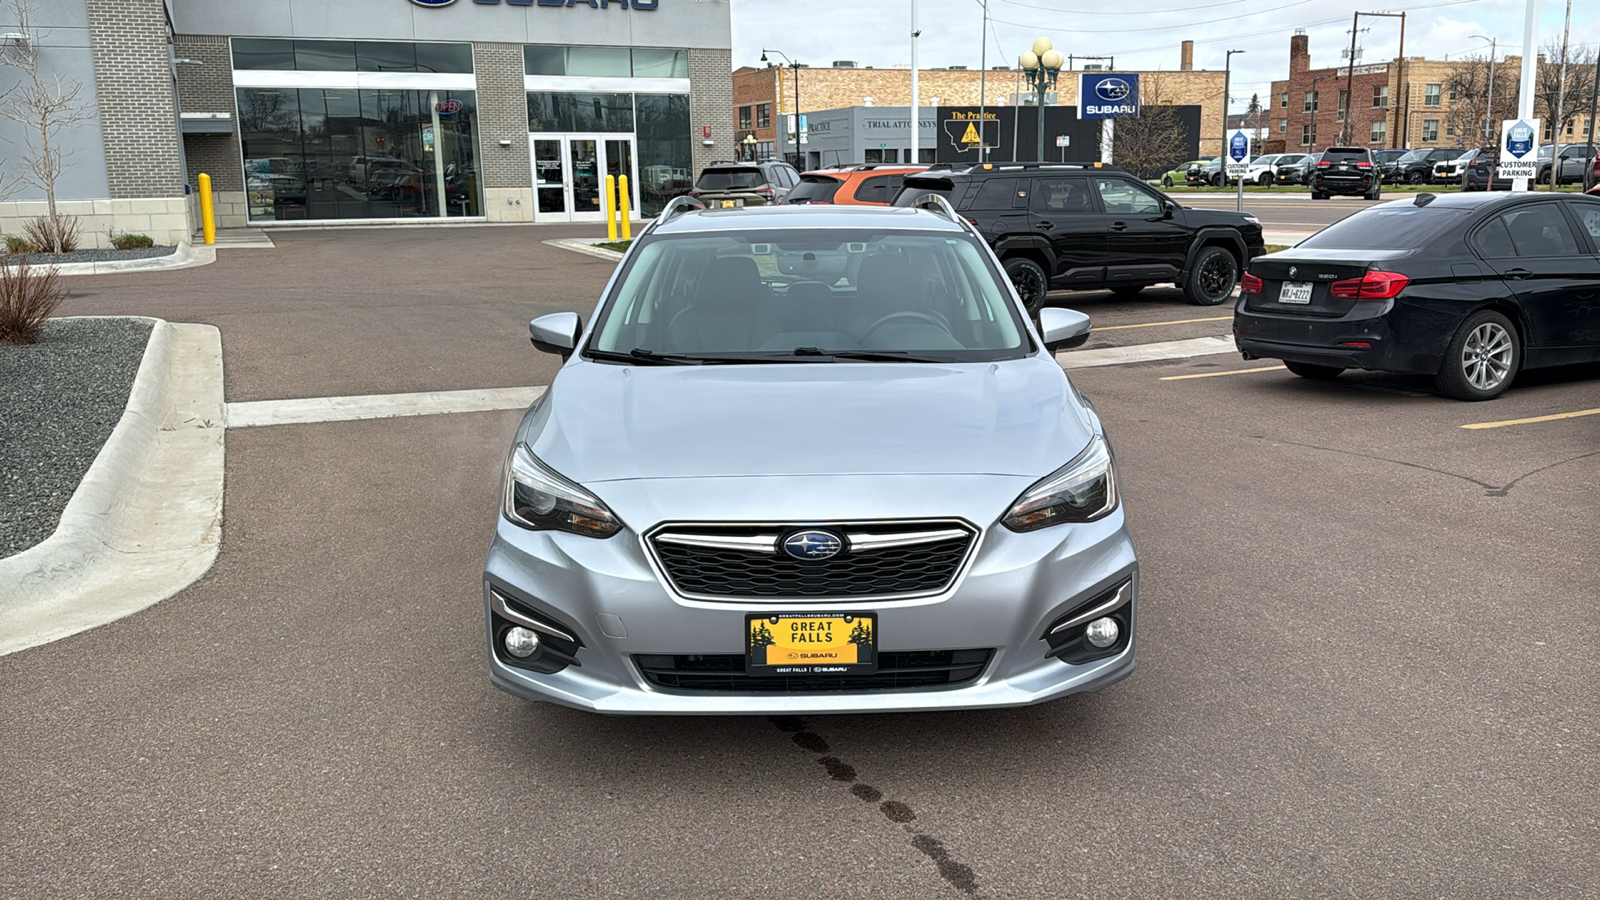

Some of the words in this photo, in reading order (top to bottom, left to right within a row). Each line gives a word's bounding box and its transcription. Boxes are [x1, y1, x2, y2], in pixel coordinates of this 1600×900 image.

[436, 101, 460, 112] OPEN
[1086, 105, 1135, 114] SUBARU
[951, 111, 966, 119] The
[967, 111, 996, 119] Pratice
[808, 122, 831, 132] PRACTICE
[791, 622, 833, 631] GREAT
[791, 632, 833, 643] FALLS
